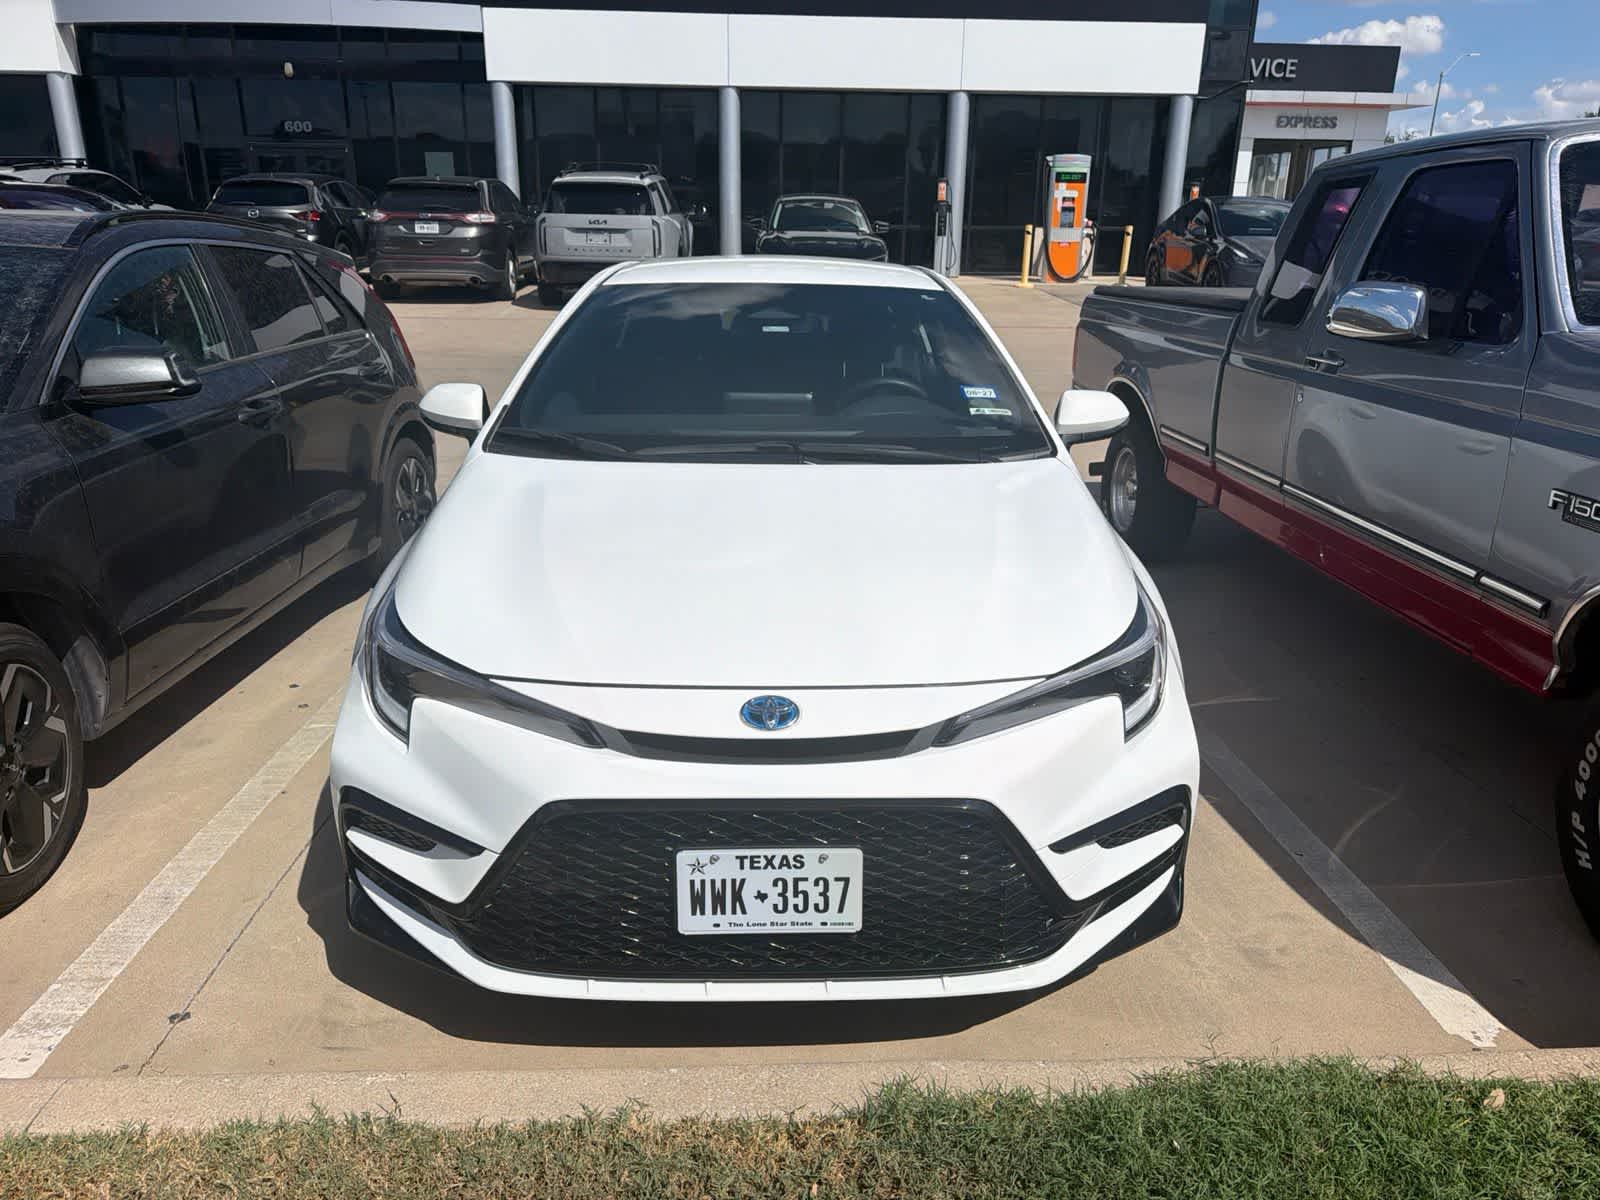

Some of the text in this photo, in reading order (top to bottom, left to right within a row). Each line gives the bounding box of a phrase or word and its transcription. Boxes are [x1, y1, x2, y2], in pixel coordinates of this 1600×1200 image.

[1250, 58, 1299, 78] VICE
[284, 120, 313, 132] 600
[1275, 115, 1338, 129] EXPRESS
[735, 854, 806, 870] TEXAS
[689, 876, 851, 916] WWK 3537
